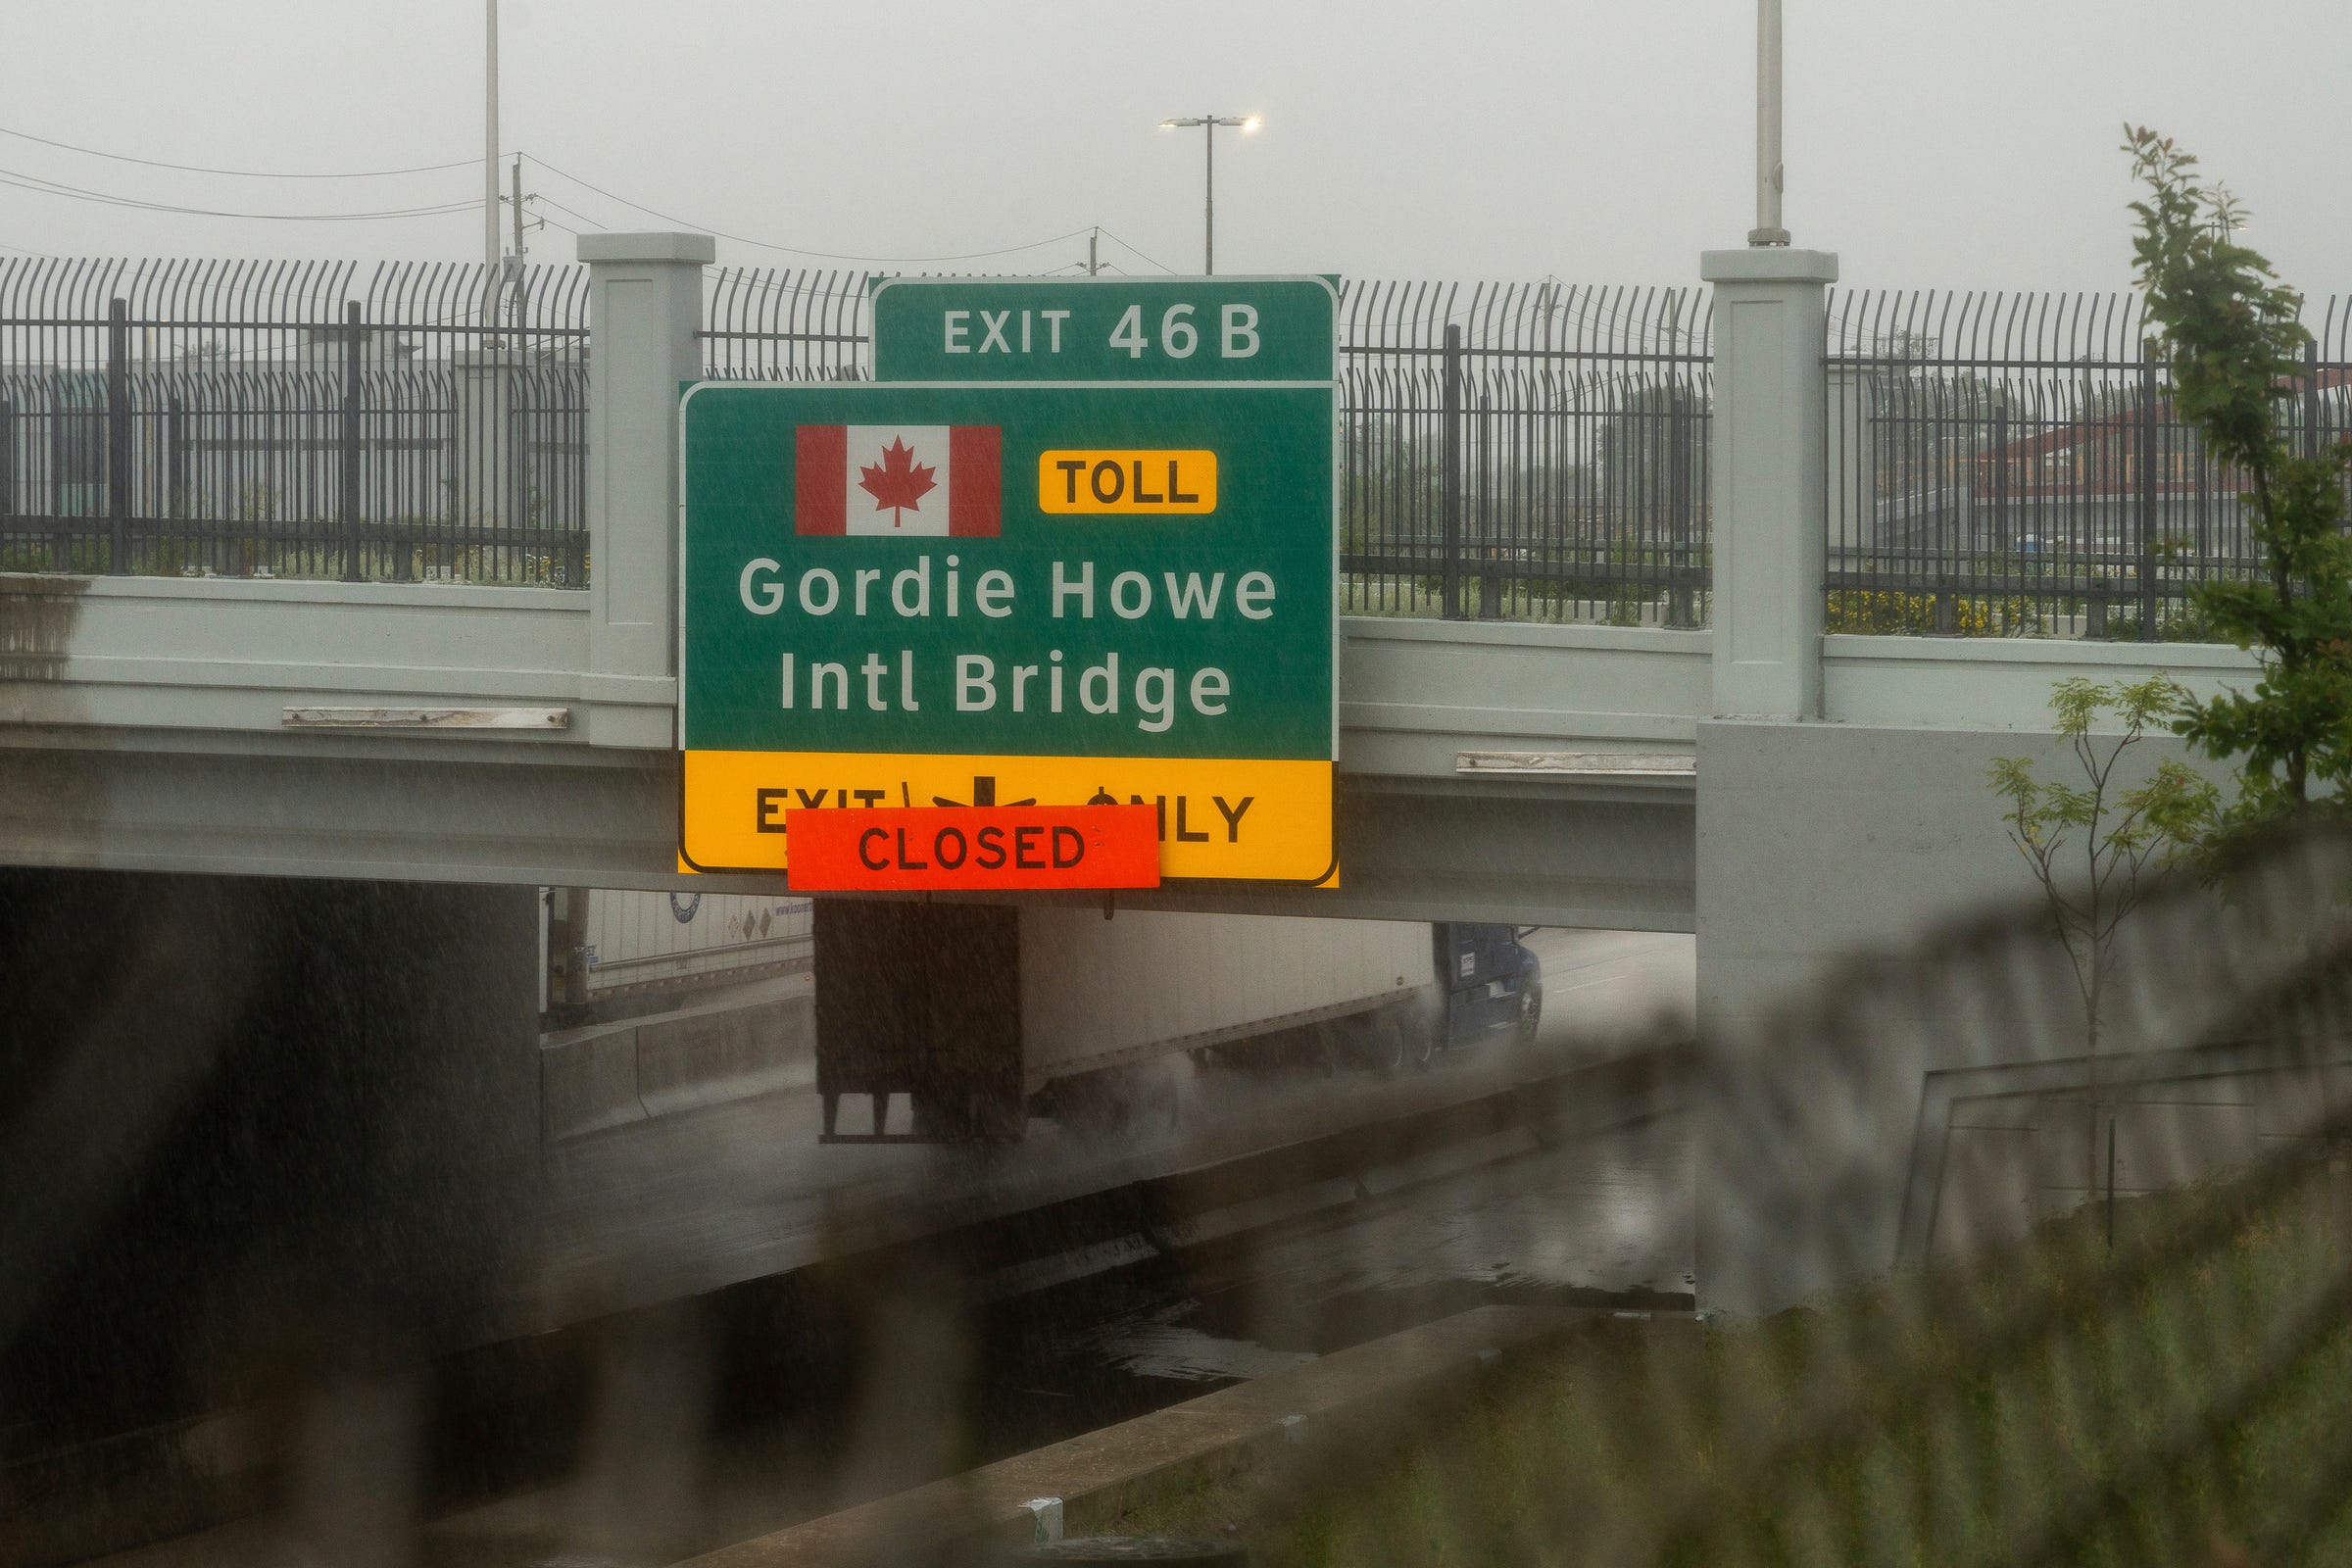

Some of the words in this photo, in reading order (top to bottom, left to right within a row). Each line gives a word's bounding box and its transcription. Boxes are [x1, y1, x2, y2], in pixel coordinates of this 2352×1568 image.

[944, 311, 1070, 354] EXIT
[1056, 461, 1200, 505] TOLL
[739, 554, 1015, 618] Gordie
[1052, 561, 1276, 619] Howe
[781, 651, 919, 711] Intl
[956, 650, 1231, 733] Bridge
[1087, 793, 1254, 843] LY
[858, 826, 1085, 870] CLOSED
